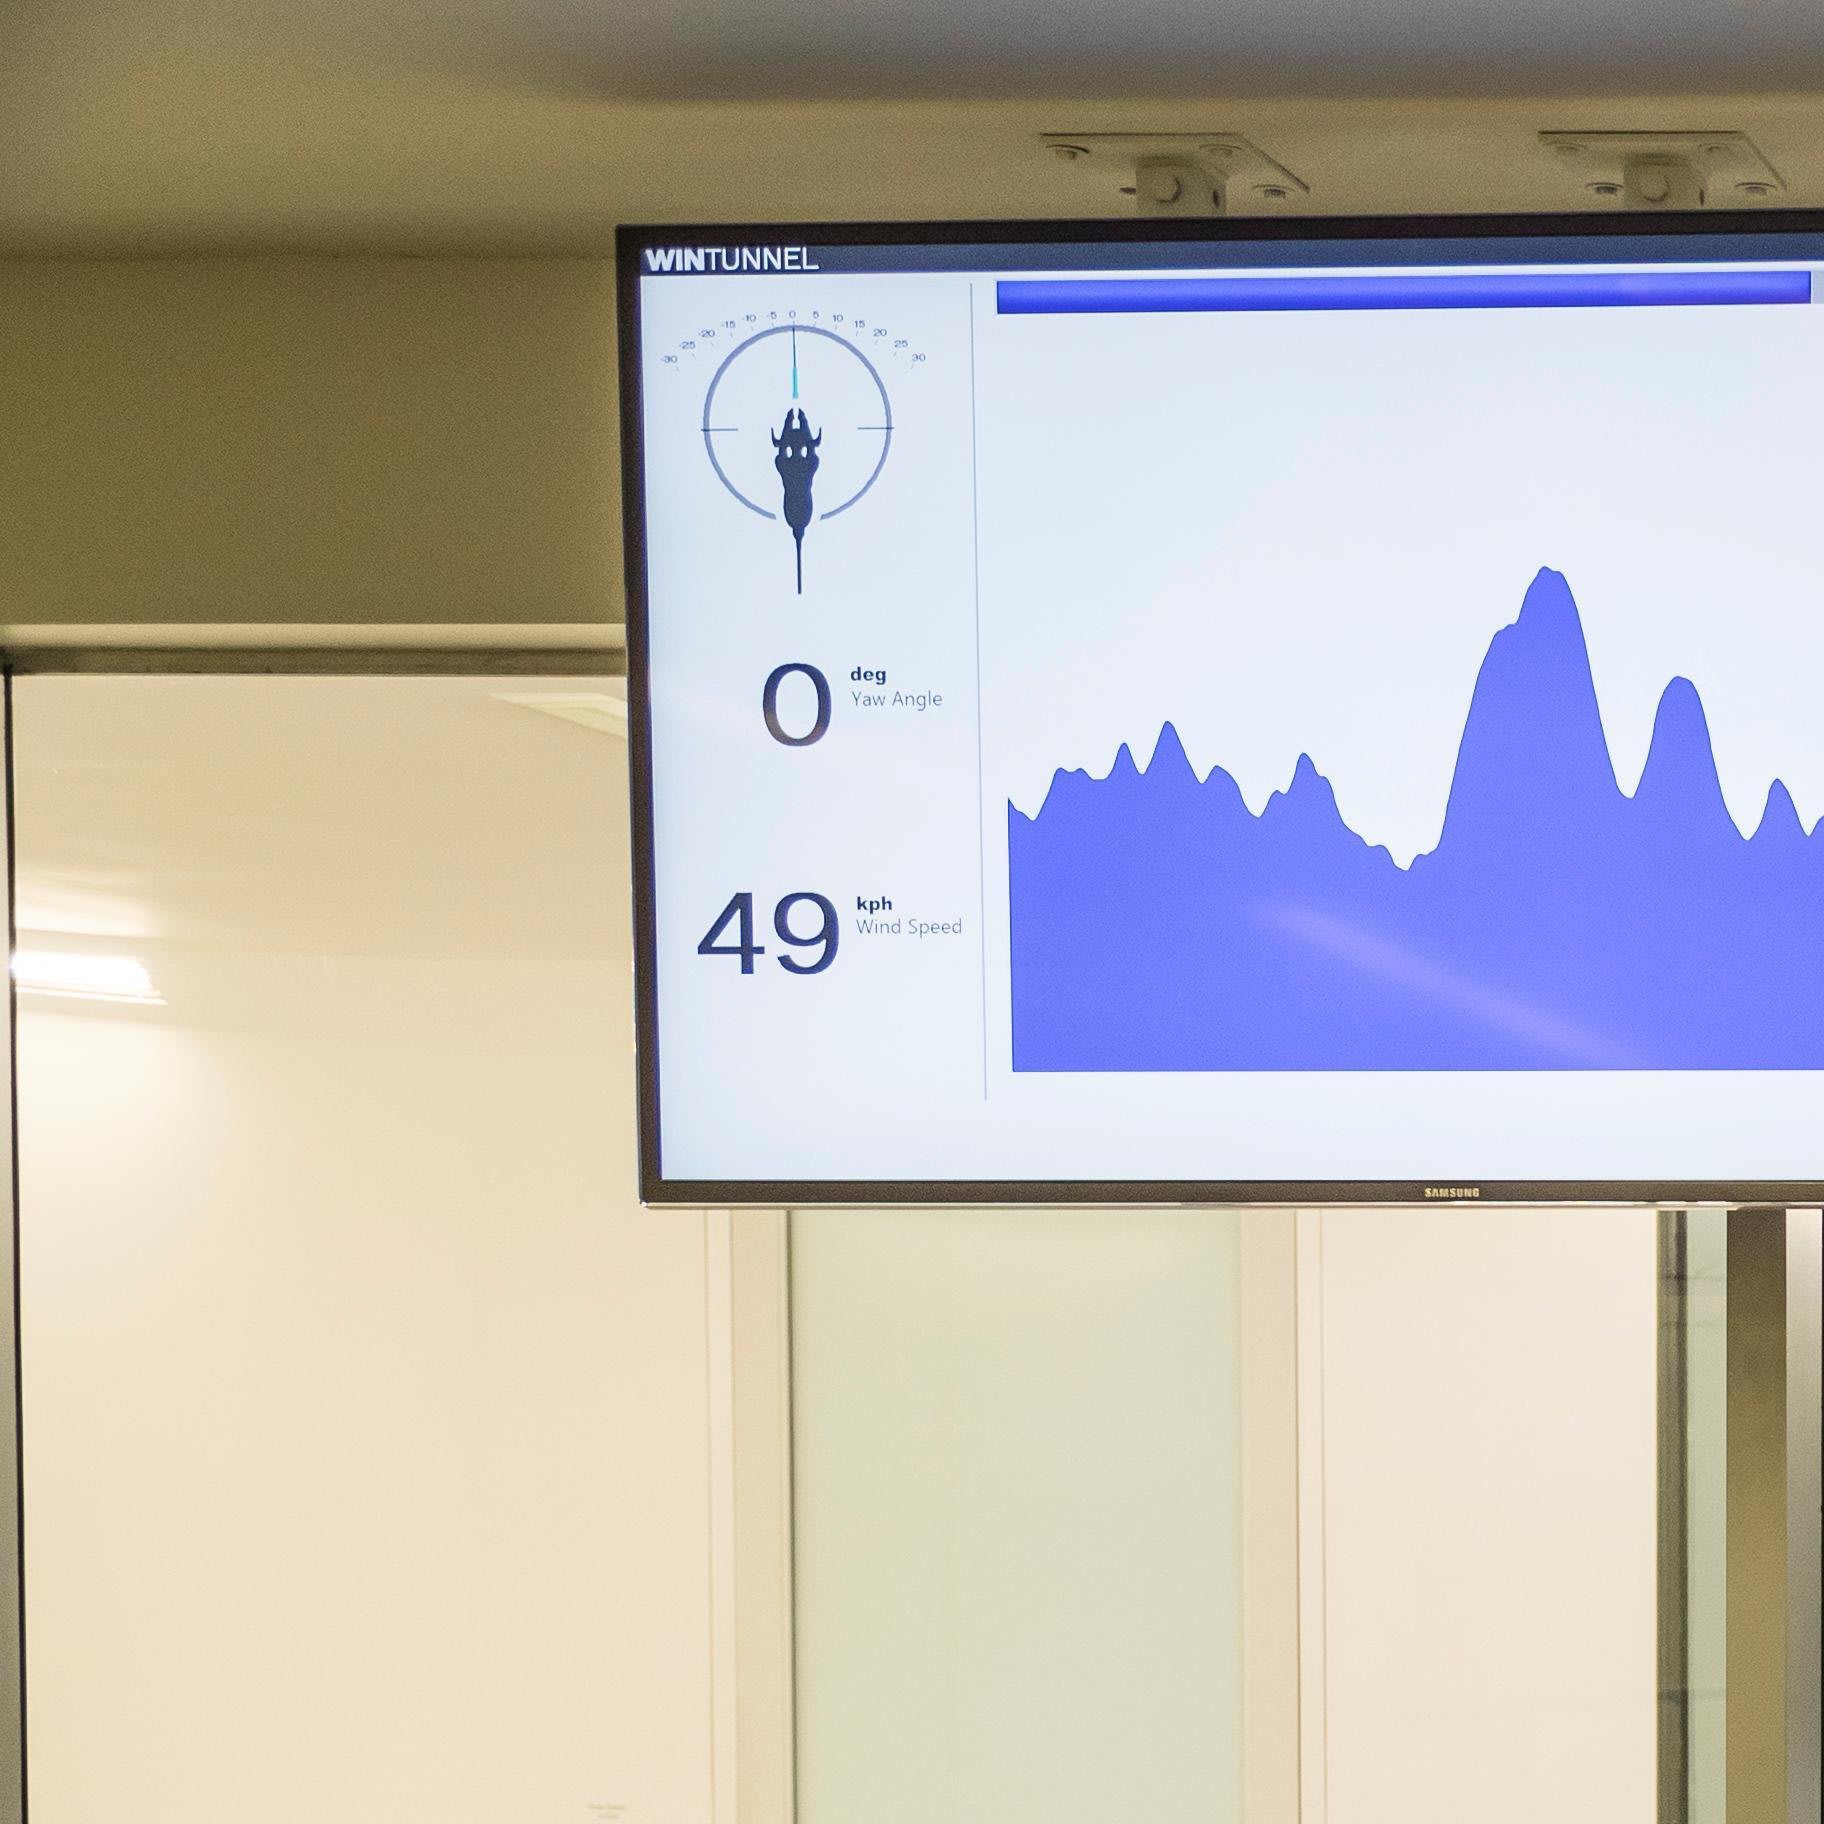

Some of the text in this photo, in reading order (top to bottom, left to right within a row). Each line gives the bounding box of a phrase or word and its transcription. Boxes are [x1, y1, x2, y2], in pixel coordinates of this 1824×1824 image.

[645, 246, 820, 272] WINTUNNEL
[660, 354, 678, 364] -30
[678, 340, 696, 350] -25
[698, 328, 715, 338] -20
[721, 320, 736, 329] -15
[741, 313, 756, 323] -10
[766, 310, 777, 320] -5
[833, 313, 844, 322] 10
[854, 319, 865, 329] 15
[873, 328, 887, 337] 20
[894, 339, 908, 348] 25
[911, 353, 926, 362] 30
[849, 666, 887, 685] deg
[762, 662, 832, 747] 0
[851, 690, 943, 711] Yaw Angle
[856, 896, 893, 914] kph
[697, 891, 840, 975] 49
[856, 918, 962, 938] Wind Speed
[1424, 1187, 1480, 1198] SAMSUNG
